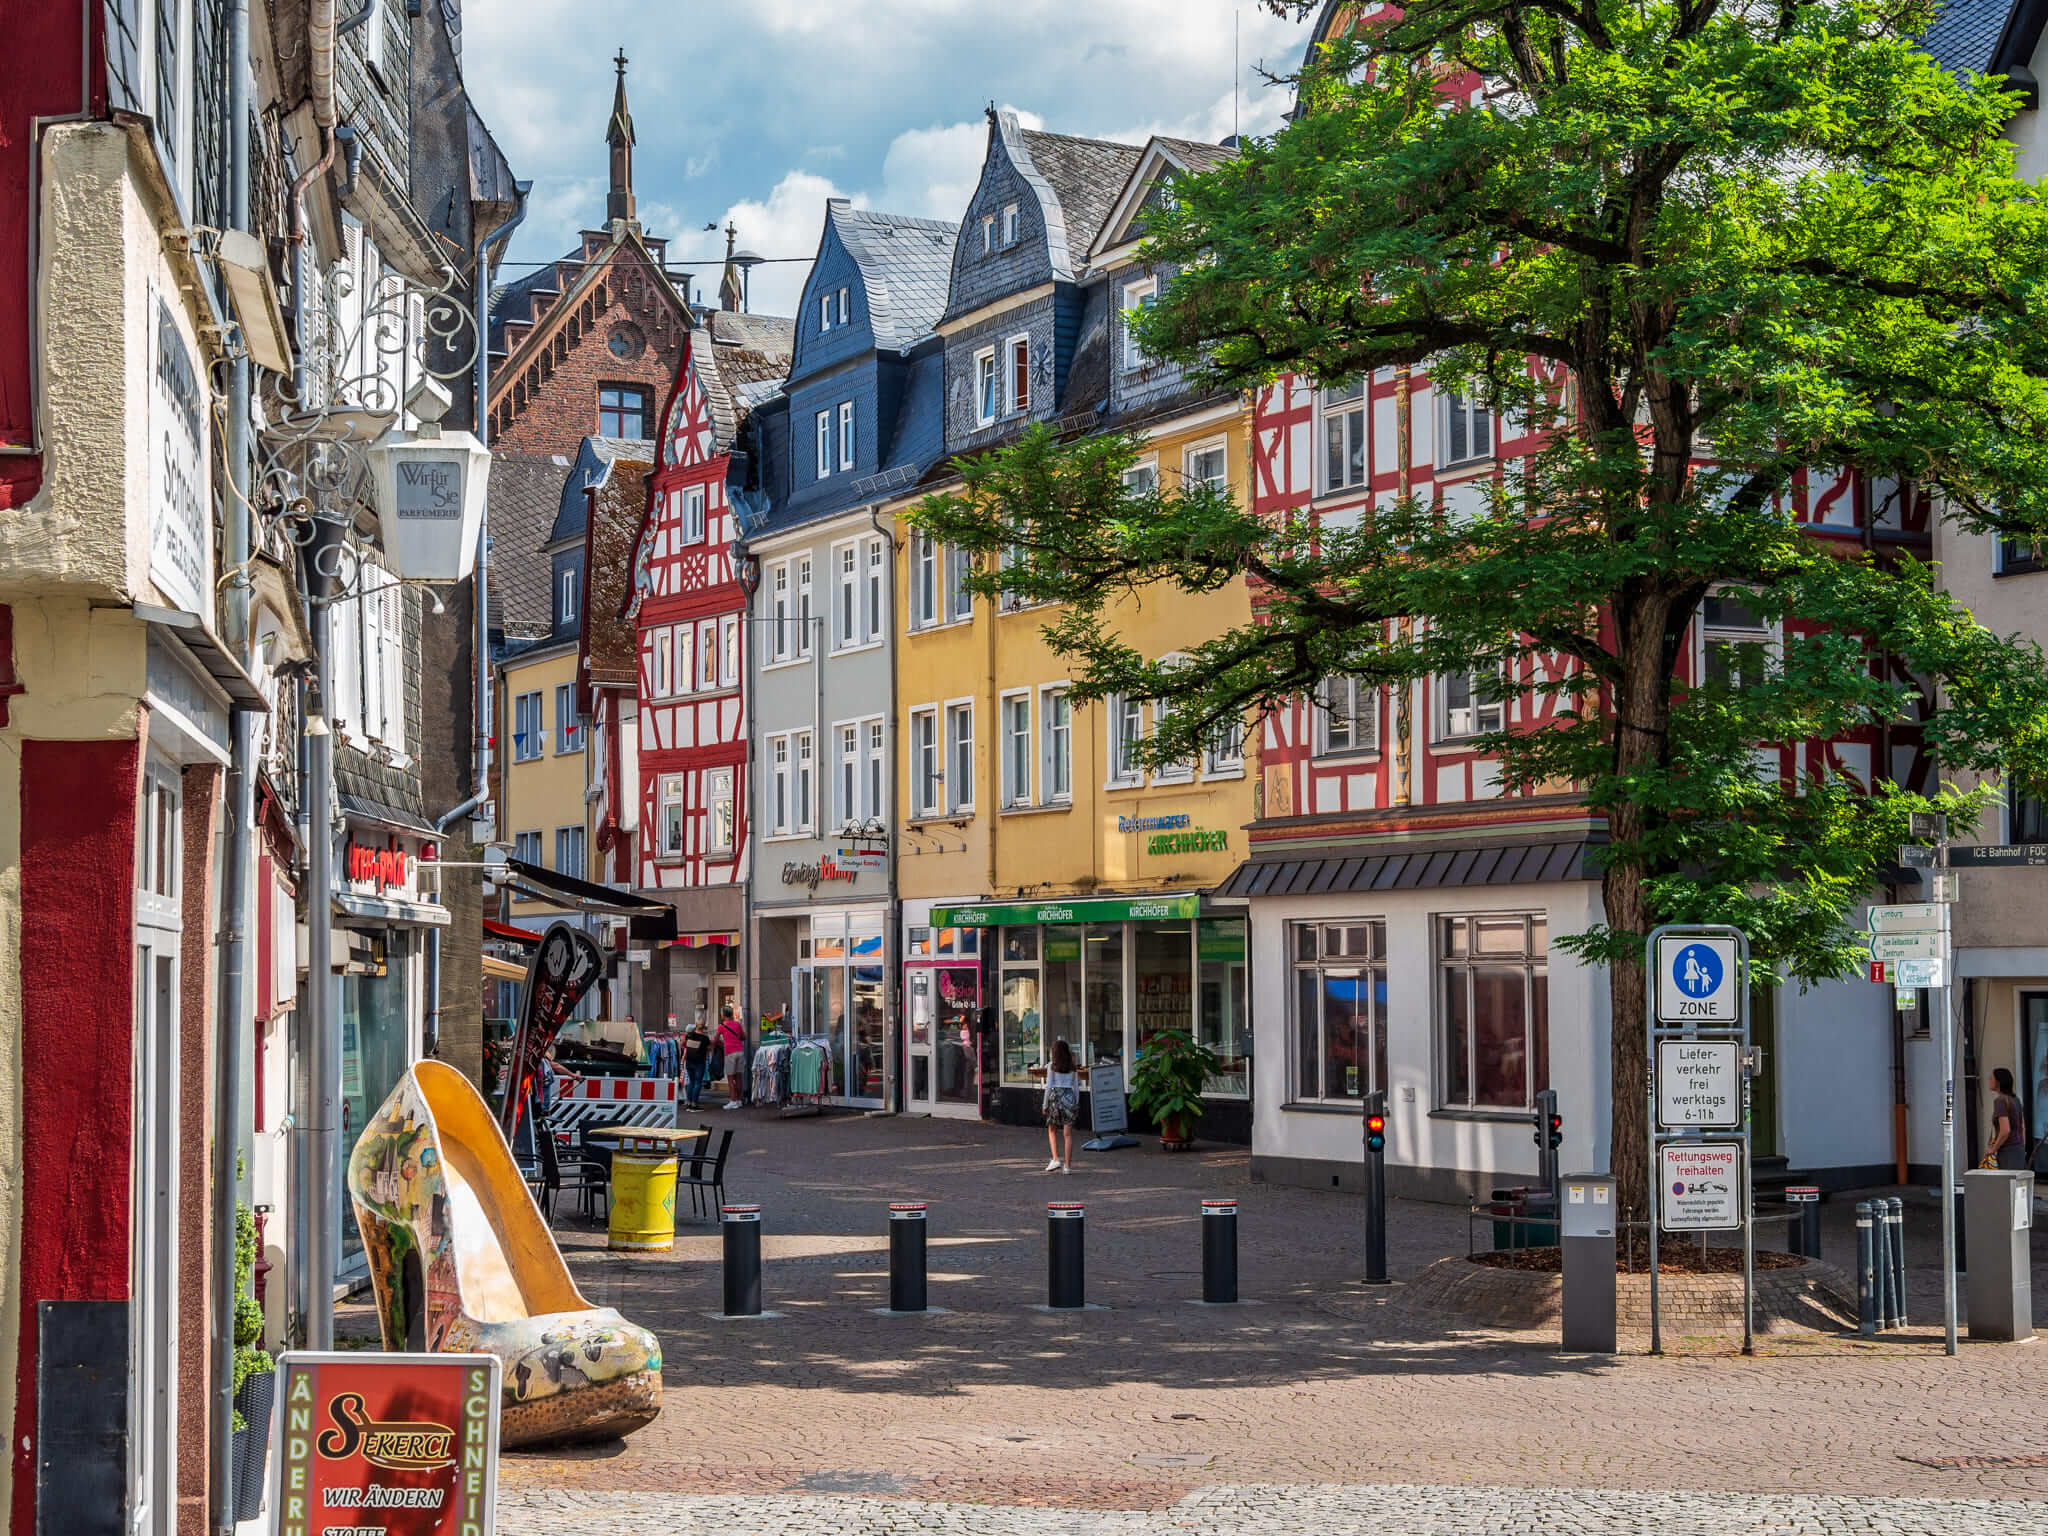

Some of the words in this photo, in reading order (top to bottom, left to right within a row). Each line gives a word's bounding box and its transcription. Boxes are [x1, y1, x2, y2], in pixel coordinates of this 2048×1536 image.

[400, 464, 430, 486] Wir
[433, 486, 459, 507] Sie
[1147, 826, 1228, 855] KIRCHHÖFER
[1973, 847, 1987, 858] ICE
[1989, 846, 2022, 858] Bahnhof
[2029, 846, 2047, 857] FOC
[1037, 907, 1073, 921] KIRCHHÖFER
[1129, 904, 1169, 918] KIRCHHÖFER
[1679, 1002, 1717, 1015] ZONE
[1679, 1048, 1717, 1060] Liefer-
[1676, 1064, 1721, 1075] verkehr
[1689, 1078, 1709, 1090] frei
[1672, 1094, 1726, 1107] werktags
[1667, 1151, 1732, 1164] Rettungsweg
[1676, 1165, 1724, 1176] freihalten
[323, 1488, 359, 1507] WIR
[363, 1484, 444, 1508] ÄNDERN
